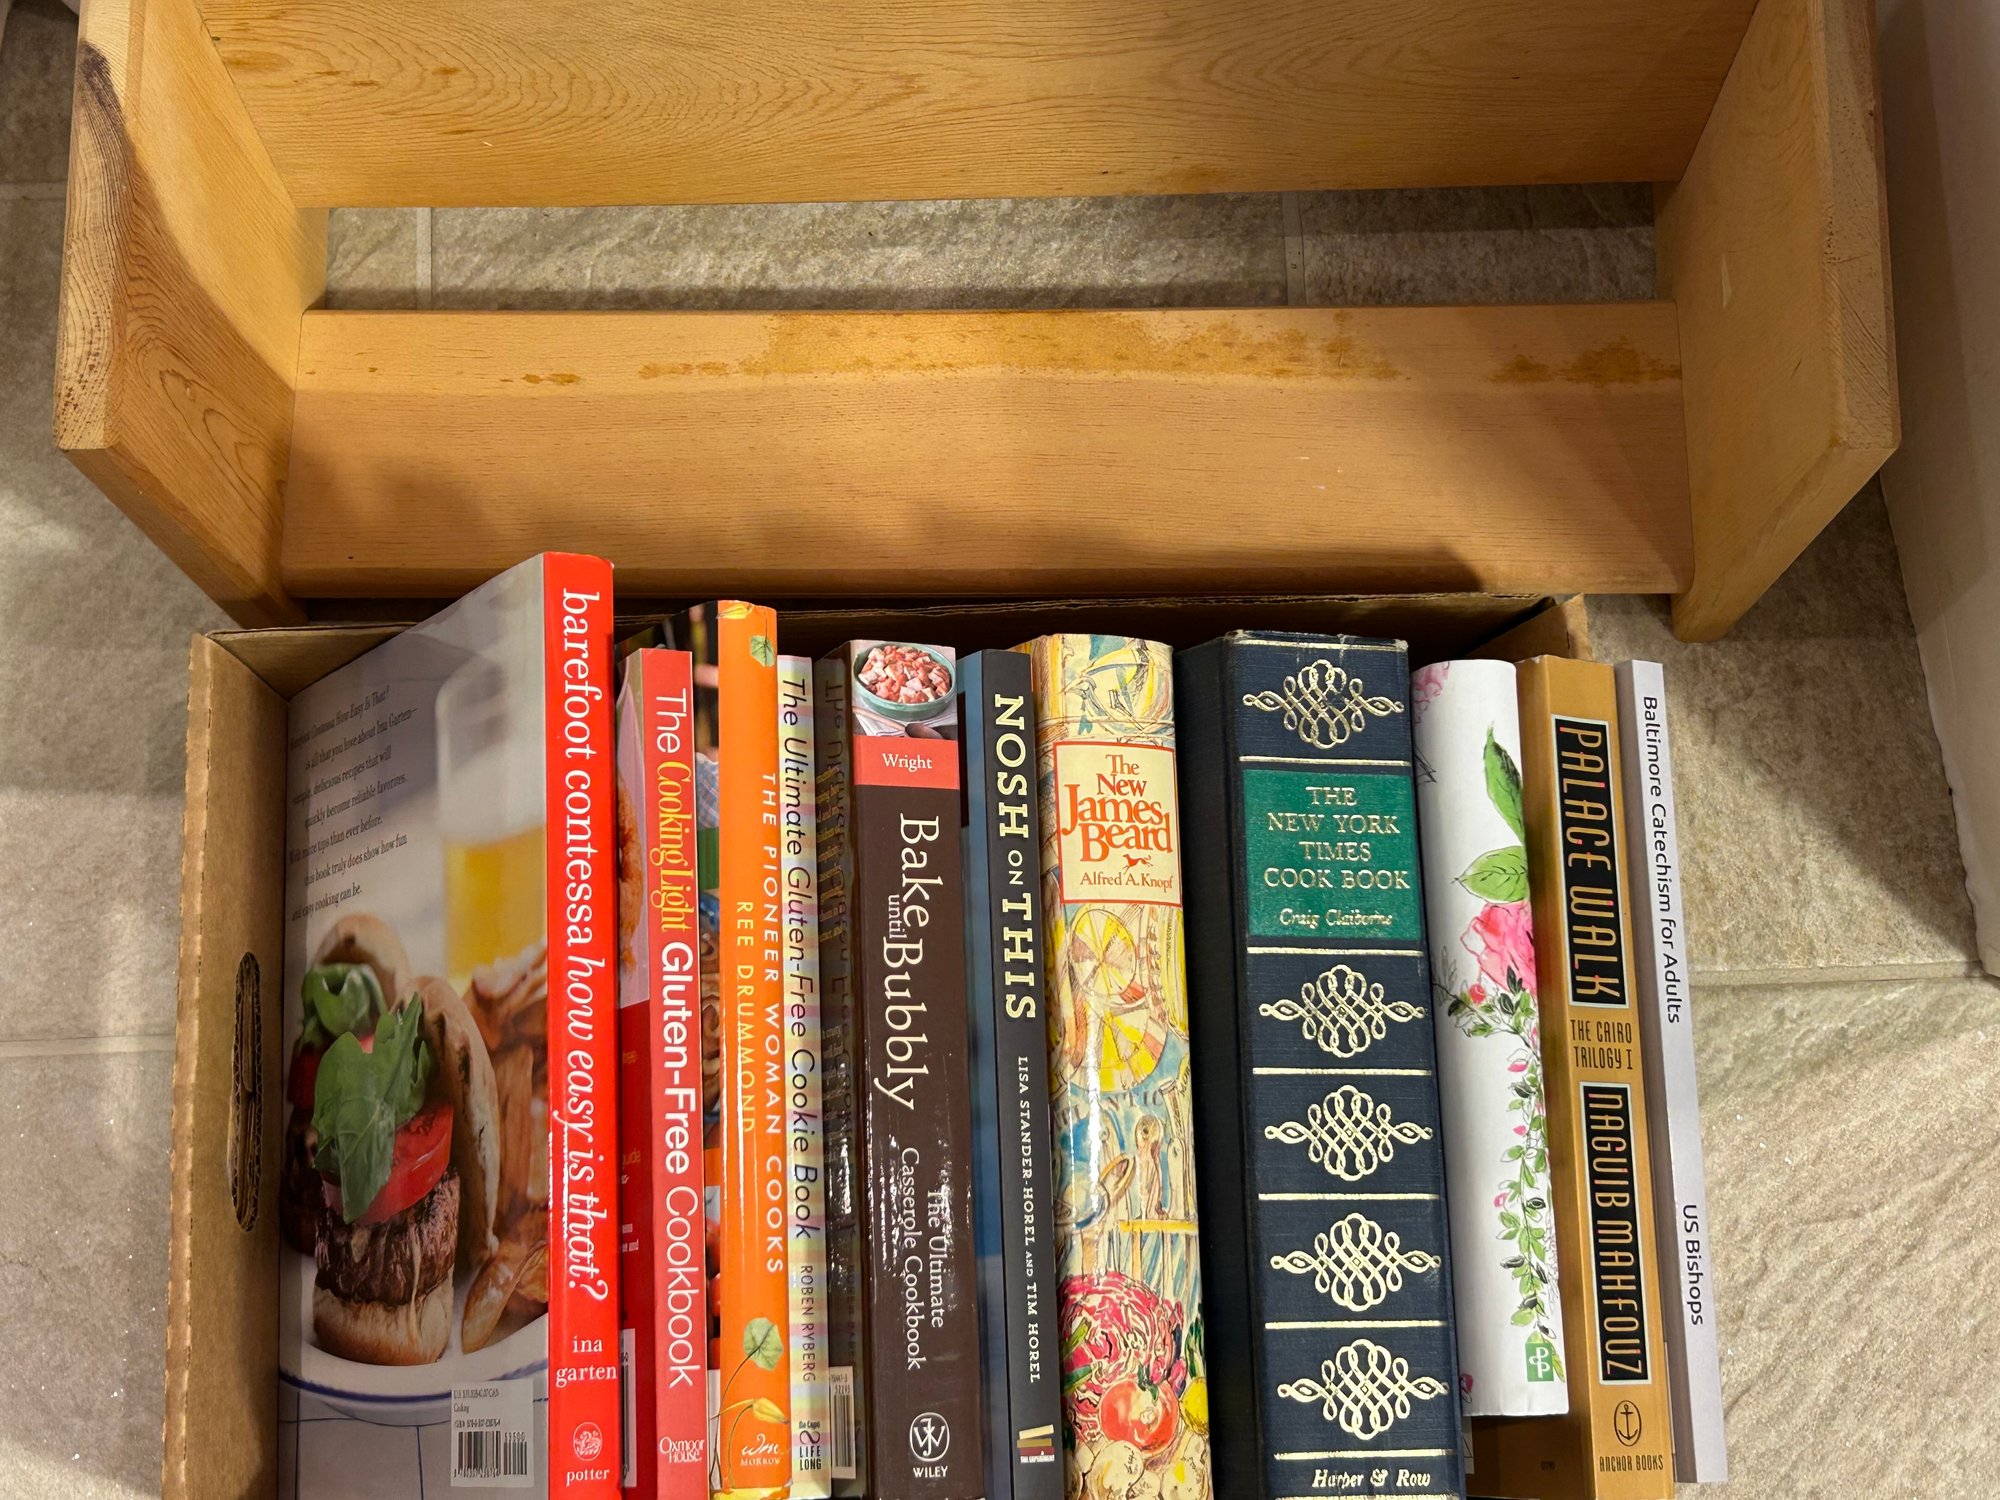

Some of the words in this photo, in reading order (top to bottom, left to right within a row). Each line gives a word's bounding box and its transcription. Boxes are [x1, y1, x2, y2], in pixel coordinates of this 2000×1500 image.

[562, 587, 603, 760] barefoot
[782, 677, 808, 727] The
[655, 687, 688, 754] The
[1642, 695, 1664, 797] Baltimore
[881, 753, 933, 773] Wright
[994, 692, 1030, 839] NOSH
[1096, 773, 1148, 798] New
[1104, 753, 1140, 775] The
[649, 760, 692, 867] Cooking
[762, 772, 777, 827] THE
[784, 736, 810, 856] Ultimate
[1061, 783, 1164, 837] James
[1266, 812, 1325, 833] NEW
[1332, 814, 1401, 835] YORK
[1305, 785, 1358, 807] THE
[1558, 724, 1612, 872] PALACE
[565, 769, 599, 948] contessa
[1078, 811, 1174, 864] Beard
[1298, 840, 1373, 862] TIMES
[1650, 803, 1673, 914] Catechism
[899, 811, 943, 928] Bake
[1007, 849, 1024, 886] ON
[1079, 870, 1123, 888] Alfred
[1124, 872, 1140, 887] A.
[1141, 872, 1174, 894] Knopf
[1263, 867, 1334, 889] COOK
[1340, 869, 1411, 890] BOOK
[650, 868, 695, 933] Light
[736, 901, 754, 947] REE
[763, 845, 780, 982] PIONEER
[886, 894, 907, 940] until
[1278, 907, 1321, 930] Craig
[787, 865, 815, 1039] Gluten-Free
[1001, 892, 1037, 1020] THIS
[1568, 886, 1622, 999] WALK
[1658, 917, 1674, 951] for
[567, 958, 606, 1041] how
[1662, 952, 1681, 1025] Adults
[736, 964, 756, 1132] DRUMMOND
[873, 937, 930, 1112] Bubbly
[1570, 1019, 1592, 1042] THE
[1596, 1020, 1633, 1044] CAIRO
[660, 941, 697, 1175] Gluten-Free
[764, 1003, 782, 1135] WOMAN
[1017, 1055, 1030, 1095] LISA
[1573, 1046, 1622, 1070] TRILOGY
[1625, 1048, 1633, 1070] I
[552, 1049, 594, 1144] easy
[791, 1048, 819, 1153] Cookie
[569, 1149, 605, 1182] is
[1019, 1099, 1036, 1245] STANDER-HOREL
[1587, 1092, 1629, 1209] NAGUIB
[766, 1155, 784, 1273] COOKS
[794, 1162, 821, 1240] Book
[901, 1147, 923, 1250] Casserole
[927, 1189, 946, 1229] The
[1682, 1203, 1700, 1236] US
[568, 1192, 608, 1302] that?
[1024, 1250, 1035, 1278] AND
[666, 1185, 701, 1389] Cookbook
[800, 1265, 814, 1317] ROBEN
[929, 1233, 949, 1329] Ultimate
[1026, 1281, 1039, 1317] TIM
[1596, 1219, 1645, 1376] MAHFOUZ
[1684, 1239, 1705, 1327] Bishops
[903, 1254, 928, 1371] Cookbook
[572, 1335, 603, 1353] ina
[802, 1323, 816, 1383] RYBERG
[1028, 1321, 1042, 1385] HOREL
[555, 1365, 617, 1388] garten
[659, 1436, 705, 1454] Oxmoor
[740, 1457, 780, 1467] MORROW
[799, 1445, 821, 1458] LIFE
[799, 1458, 822, 1471] LONG
[912, 1465, 949, 1479] WILEY
[1599, 1455, 1633, 1473] ANCHOR
[1635, 1454, 1664, 1471] BOOKS
[566, 1468, 611, 1487] potter
[1311, 1468, 1365, 1490] Harper
[1369, 1467, 1389, 1488] &
[1395, 1468, 1432, 1488] Row
